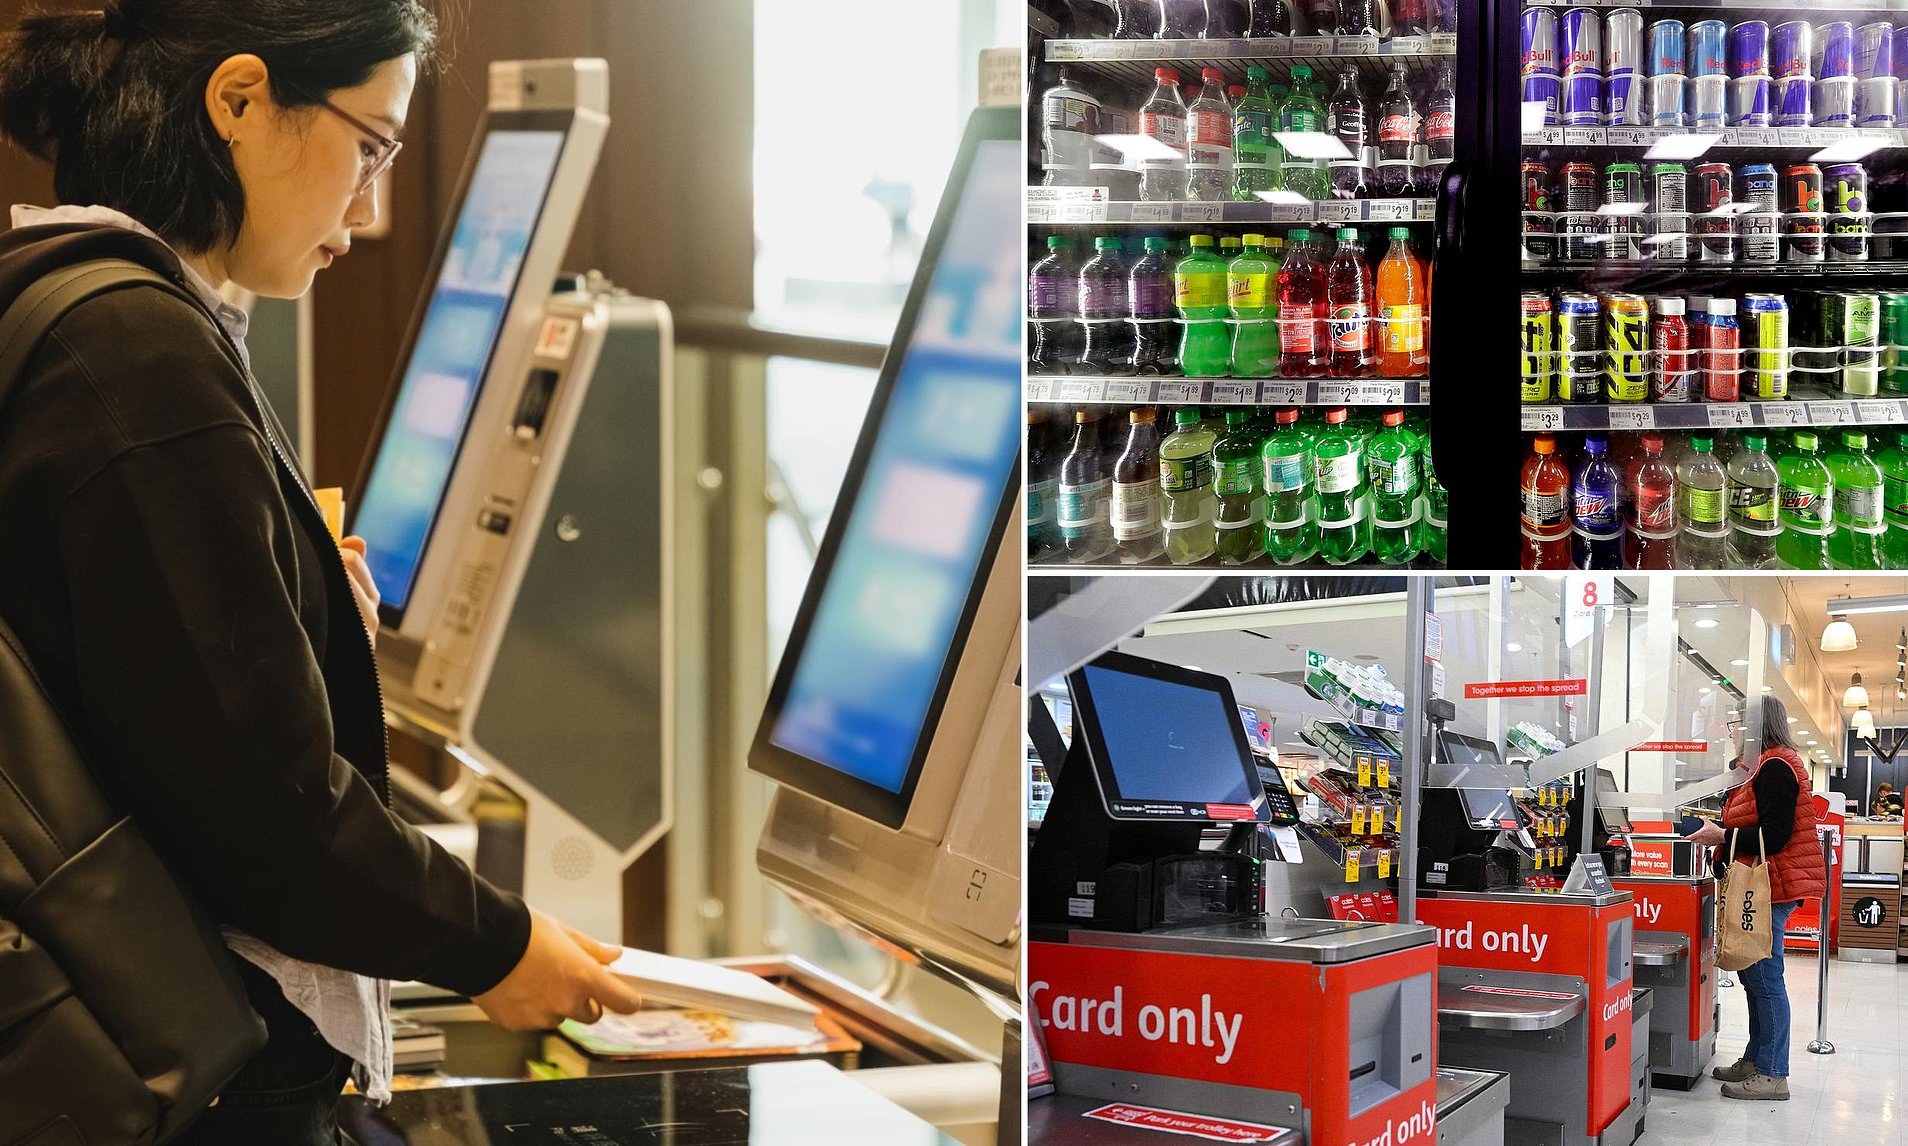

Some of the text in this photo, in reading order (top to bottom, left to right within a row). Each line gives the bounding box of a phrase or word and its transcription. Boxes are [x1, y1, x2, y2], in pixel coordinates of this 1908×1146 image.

[1582, 581, 1598, 607] 8
[1472, 686, 1504, 695] Together
[1518, 685, 1535, 693] stop
[1536, 684, 1550, 692] the
[1551, 683, 1579, 692] spread
[1637, 861, 1653, 869] every
[1653, 861, 1669, 869] scan
[1646, 851, 1662, 859] value
[1742, 890, 1757, 932] coles
[1482, 924, 1548, 962] only
[1602, 990, 1633, 1022] Card only
[1028, 981, 1243, 1065] Card only
[1397, 1100, 1437, 1145] only
